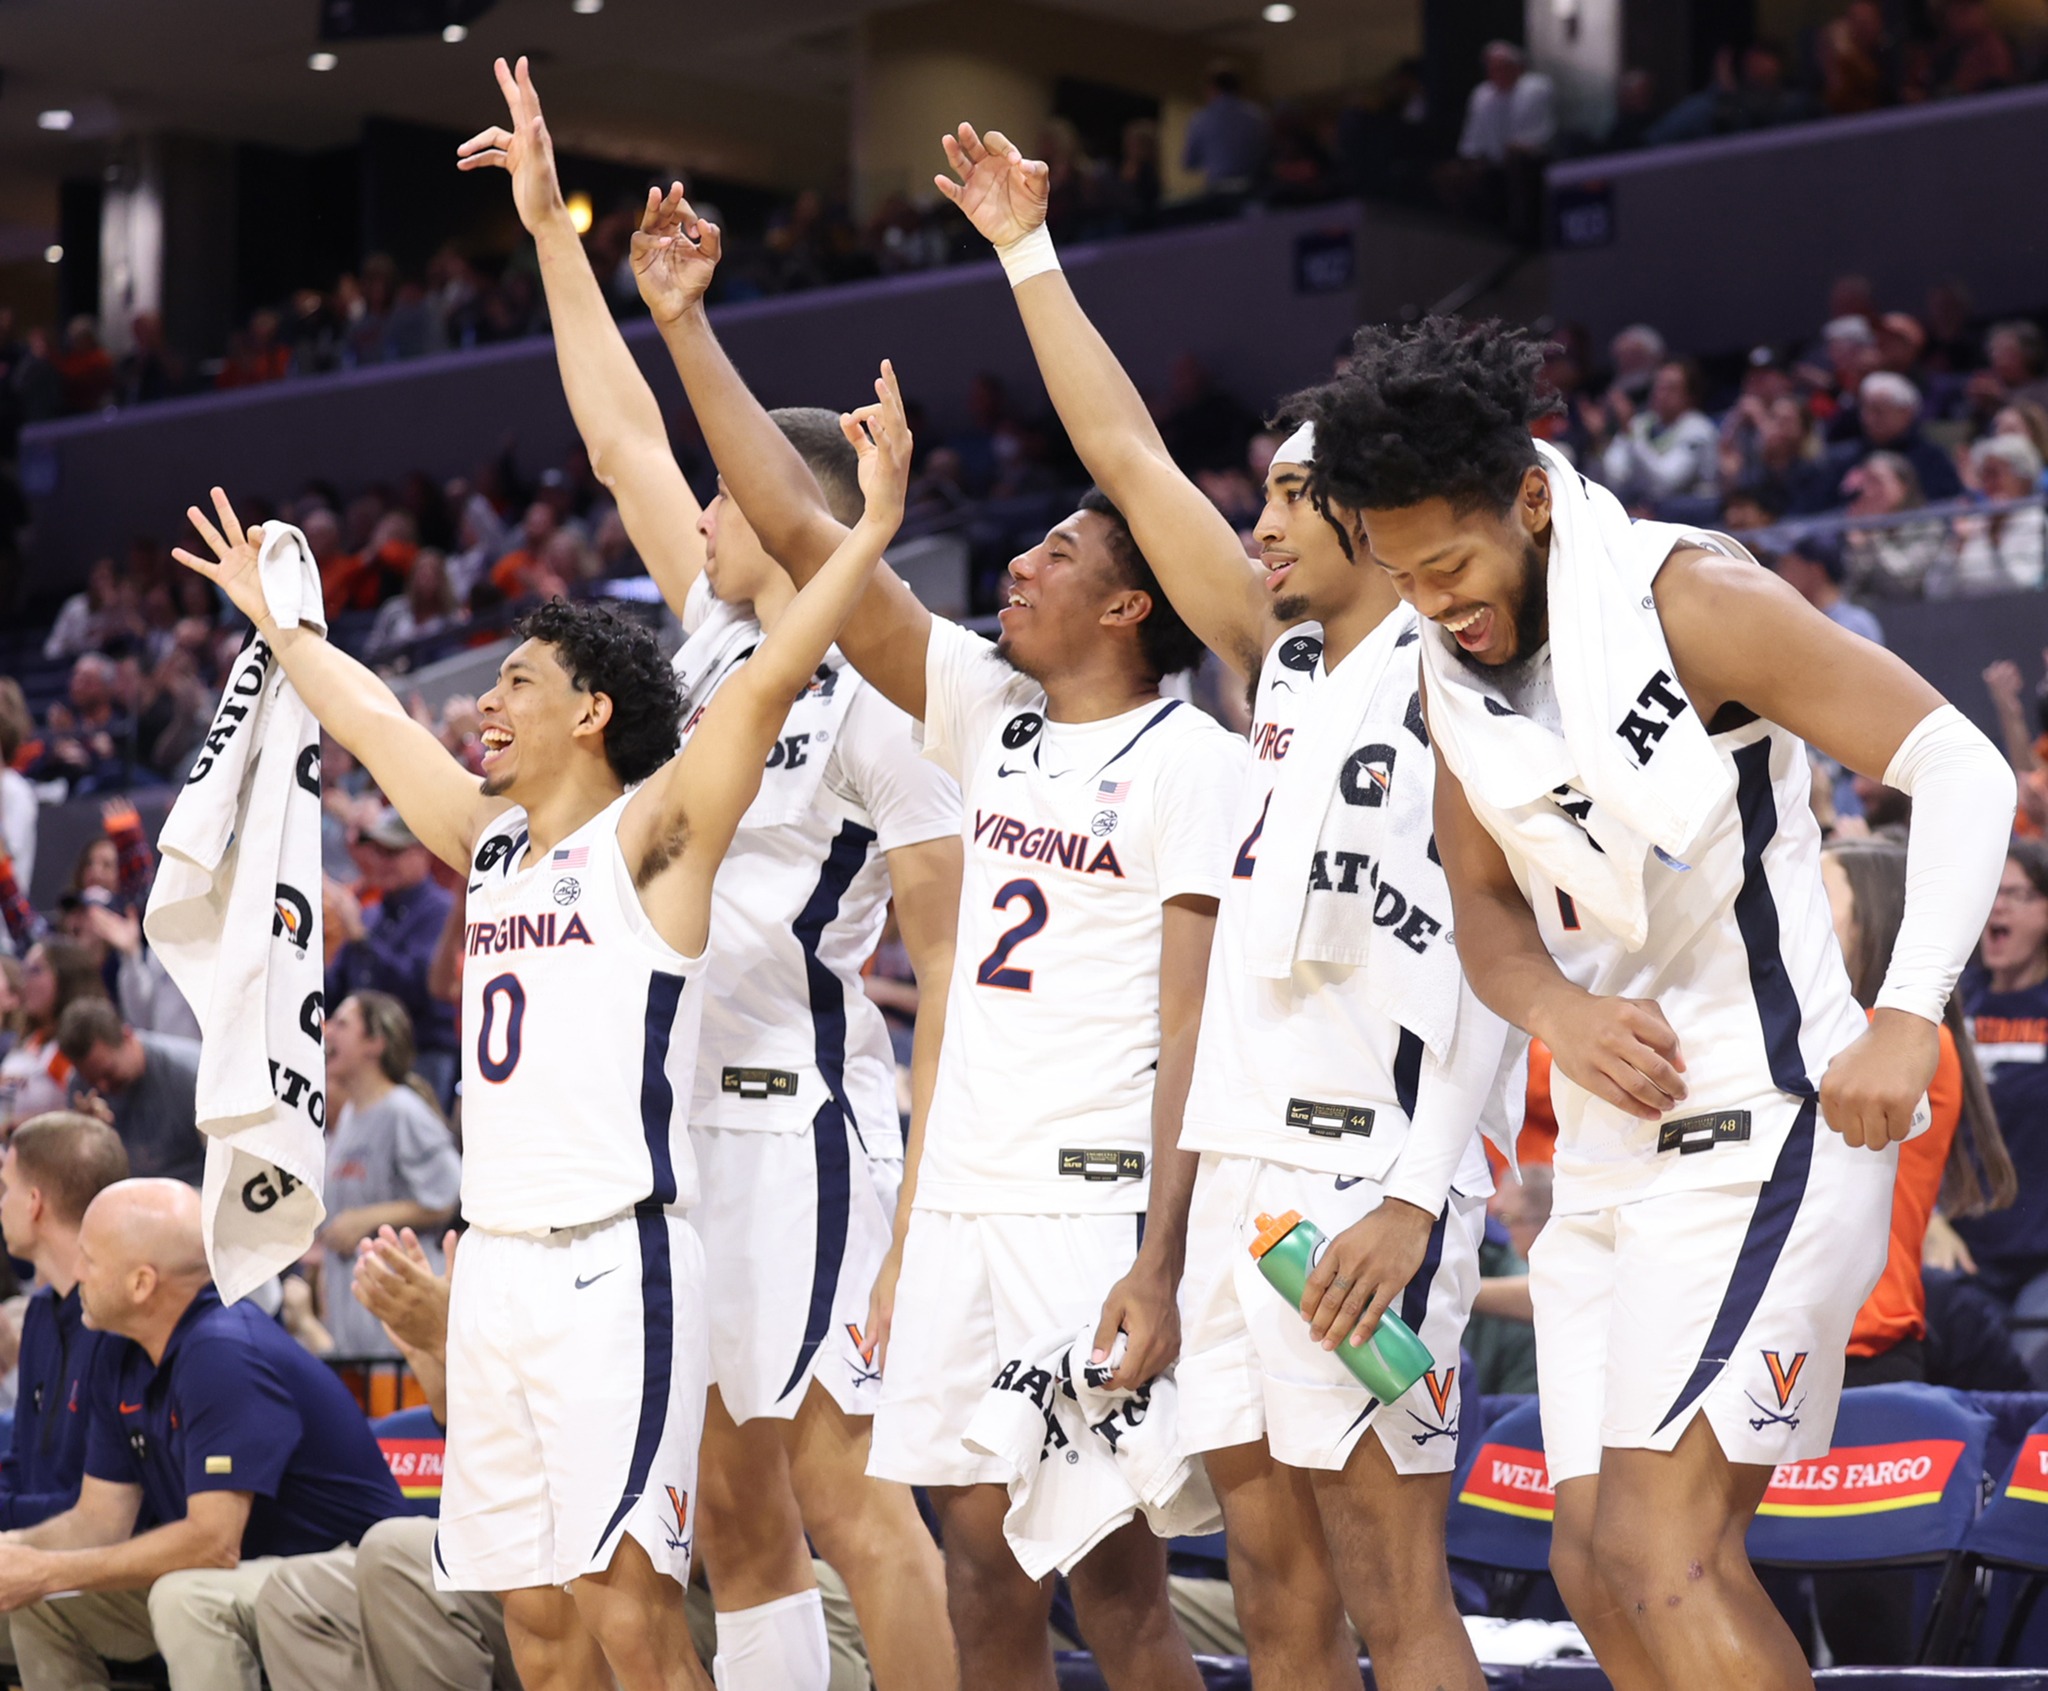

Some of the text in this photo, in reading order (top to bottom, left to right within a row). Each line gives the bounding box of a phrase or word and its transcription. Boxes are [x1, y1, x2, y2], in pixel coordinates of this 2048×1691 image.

[973, 809, 1126, 879] VIRGINIA
[976, 878, 1049, 993] 2
[477, 971, 526, 1085] 0
[1350, 1115, 1366, 1127] 44
[1719, 1119, 1736, 1132] 48
[1123, 1158, 1139, 1170] 44
[383, 1452, 418, 1477] LS
[1842, 1455, 1933, 1490] FARGO
